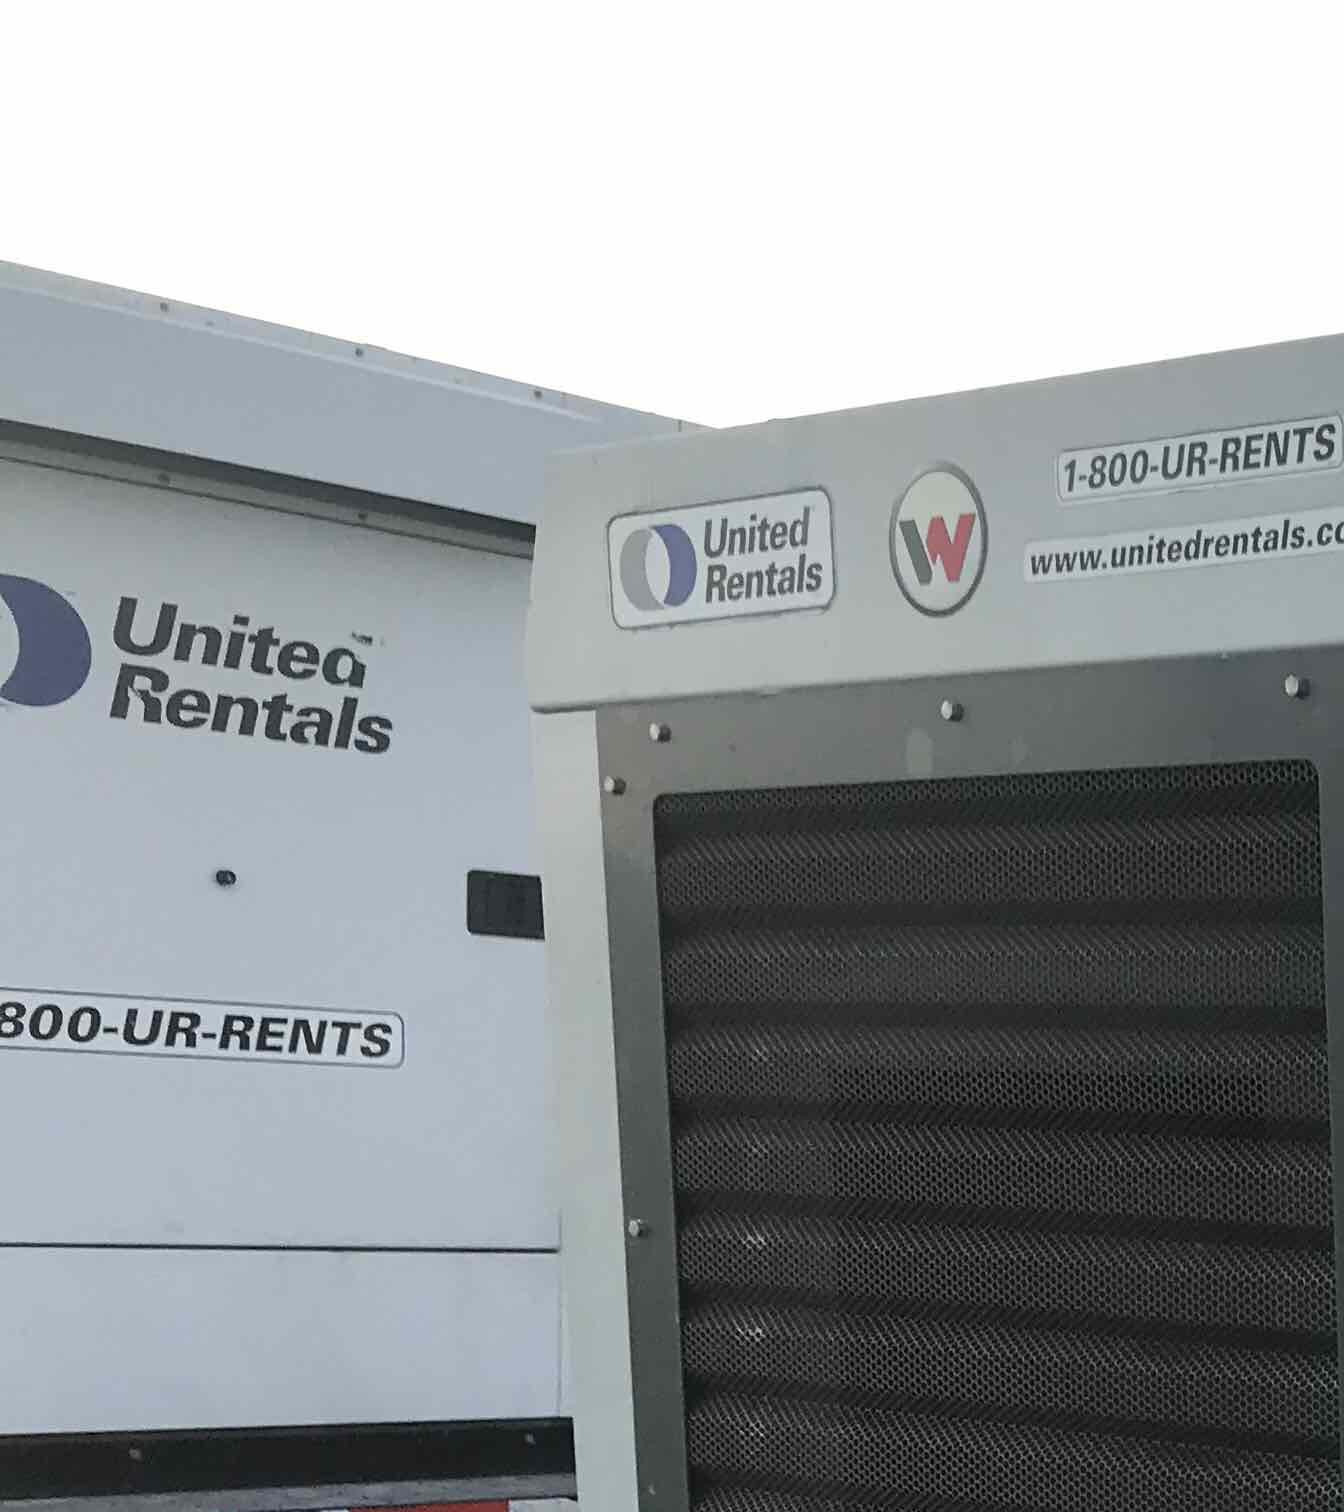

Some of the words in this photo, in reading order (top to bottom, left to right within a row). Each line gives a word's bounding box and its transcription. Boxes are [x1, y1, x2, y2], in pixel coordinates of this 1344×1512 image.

[1063, 423, 1337, 494] 1-800-UR-RENTS
[703, 508, 812, 560] United
[704, 554, 823, 604] Rentals
[112, 597, 367, 689] United
[109, 662, 394, 756] Rentals
